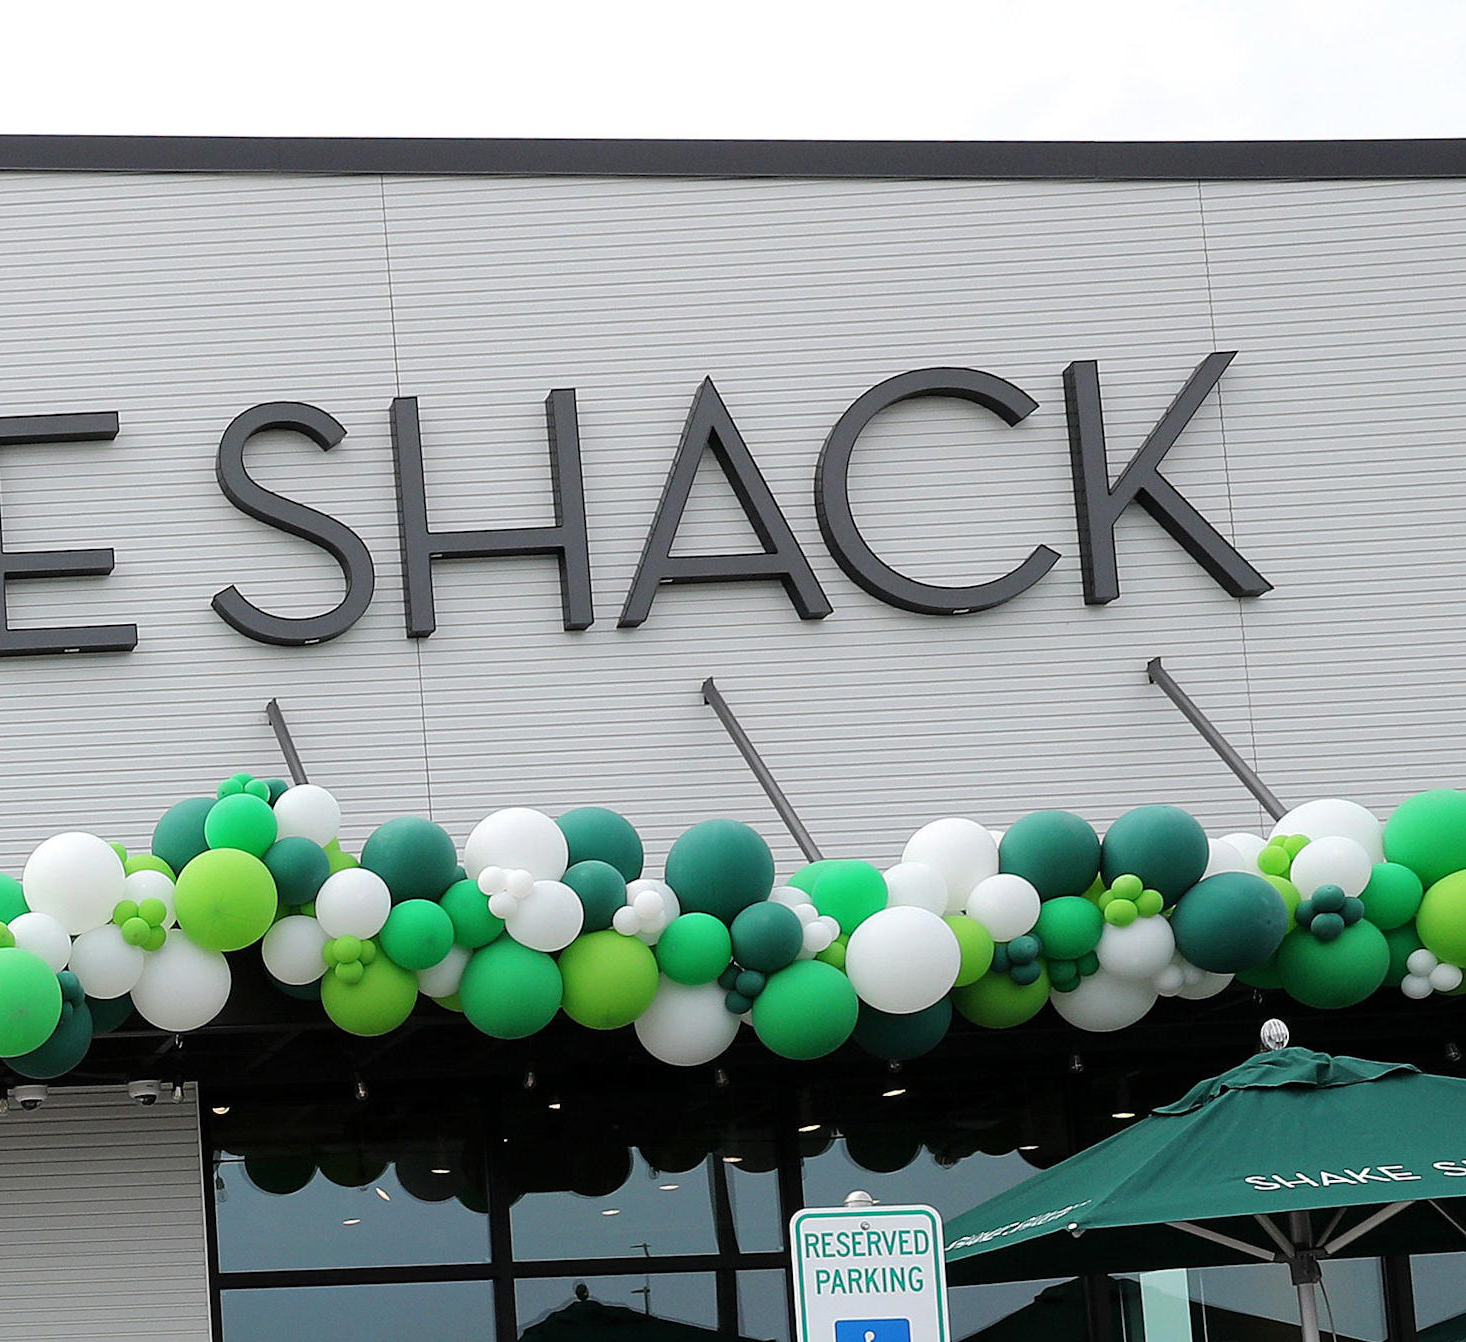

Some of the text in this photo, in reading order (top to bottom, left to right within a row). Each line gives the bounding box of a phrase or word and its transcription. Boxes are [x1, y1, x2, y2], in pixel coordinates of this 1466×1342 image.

[211, 351, 1274, 655] SHACK
[1244, 1165, 1422, 1191] SHAKE
[804, 1229, 930, 1258] RESERVED
[816, 1266, 924, 1295] PARKING
